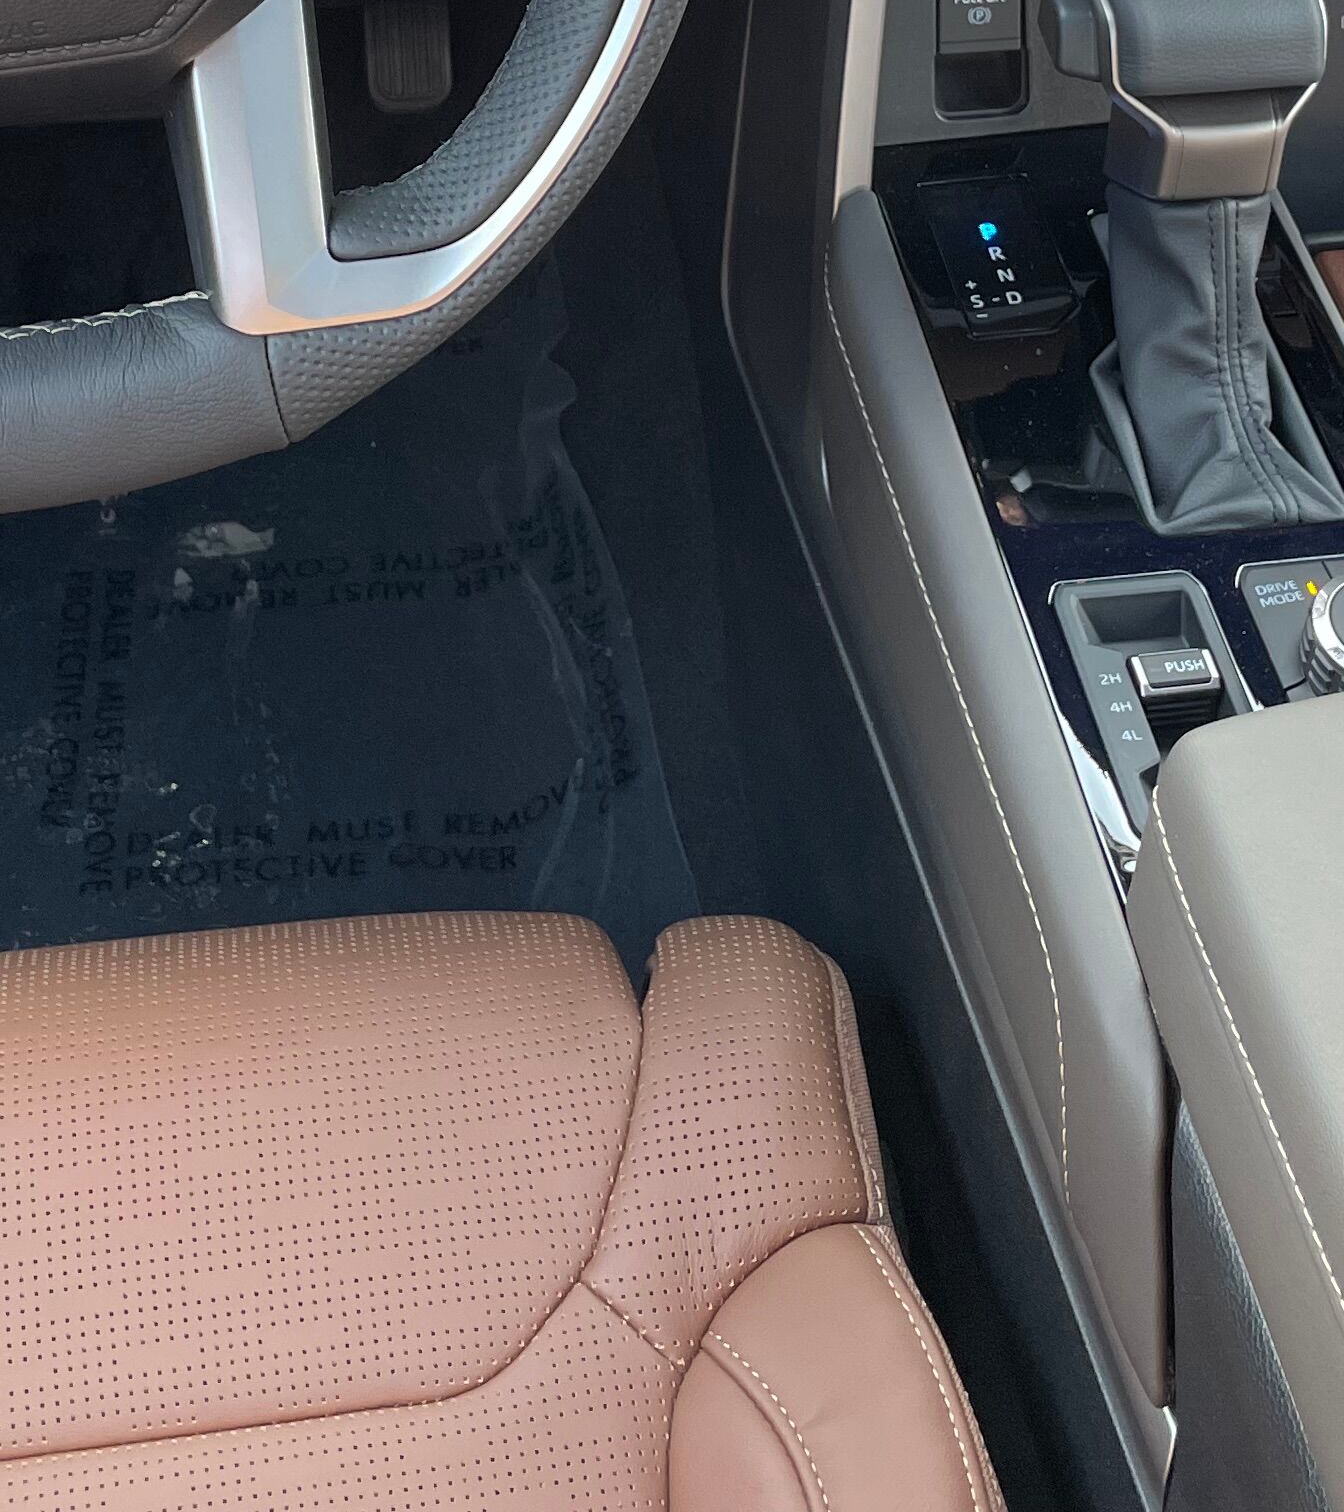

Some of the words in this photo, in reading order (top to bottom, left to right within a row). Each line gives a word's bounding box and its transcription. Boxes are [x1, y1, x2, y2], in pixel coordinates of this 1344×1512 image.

[978, 221, 998, 241] P
[987, 246, 1007, 262] R
[996, 267, 1017, 283] N
[969, 294, 985, 309] S
[1006, 290, 1023, 305] D
[1254, 579, 1298, 598] DRIVE
[1258, 590, 1305, 608] MODE
[1164, 657, 1205, 675] PUSH
[1099, 672, 1123, 687] 2H
[1109, 699, 1134, 714] 4H
[1121, 727, 1144, 742] 4L
